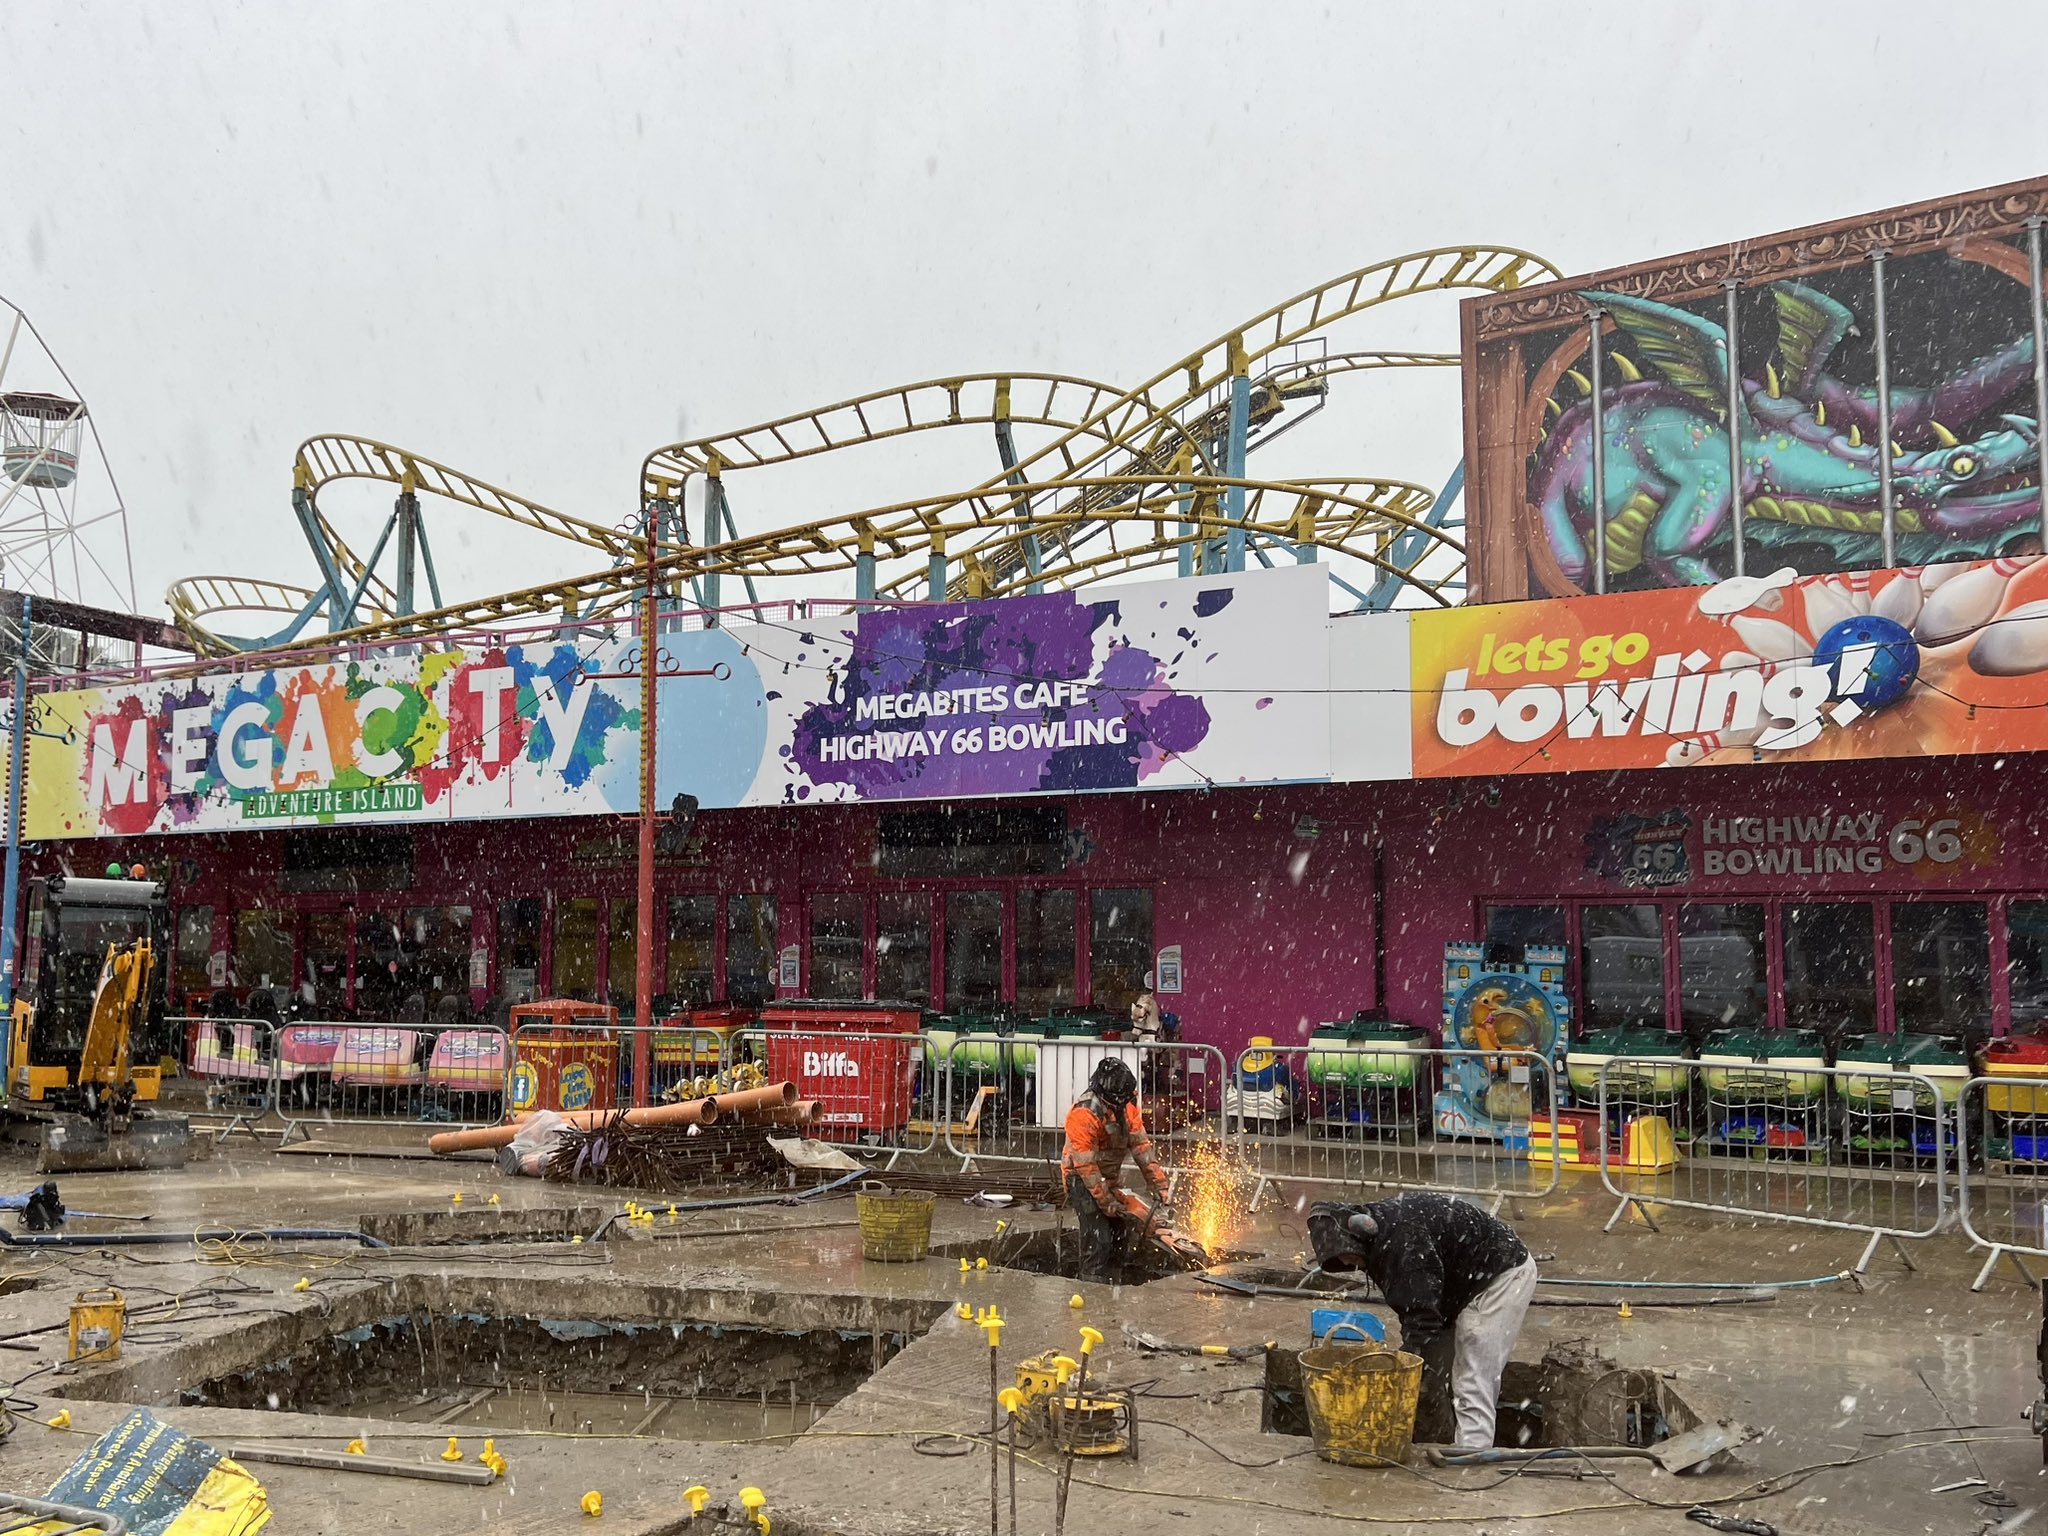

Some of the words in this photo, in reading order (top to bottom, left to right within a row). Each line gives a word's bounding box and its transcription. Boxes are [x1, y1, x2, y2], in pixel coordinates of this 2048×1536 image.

[1475, 632, 1569, 675] lets
[1574, 631, 1650, 678] go
[855, 684, 1009, 722] MEGABITES
[1013, 680, 1089, 710] CAFE
[1436, 641, 1878, 751] bowling!
[819, 729, 948, 762] HIGHWAY
[951, 727, 983, 755] 66
[988, 717, 1127, 752] BOWLING
[247, 790, 343, 816] ADVENTURE
[352, 786, 418, 811] ISLAND
[1702, 814, 1884, 844] HIGHWAY
[1888, 818, 1964, 865] 66
[1632, 842, 1677, 870] 66
[1703, 846, 1884, 876] BOWLING
[803, 1051, 860, 1077] Biffa
[103, 1416, 143, 1461] Concrete
[136, 1421, 169, 1459] ormwork
[82, 1459, 113, 1493] Repair
[128, 1440, 187, 1505] Waterproofing
